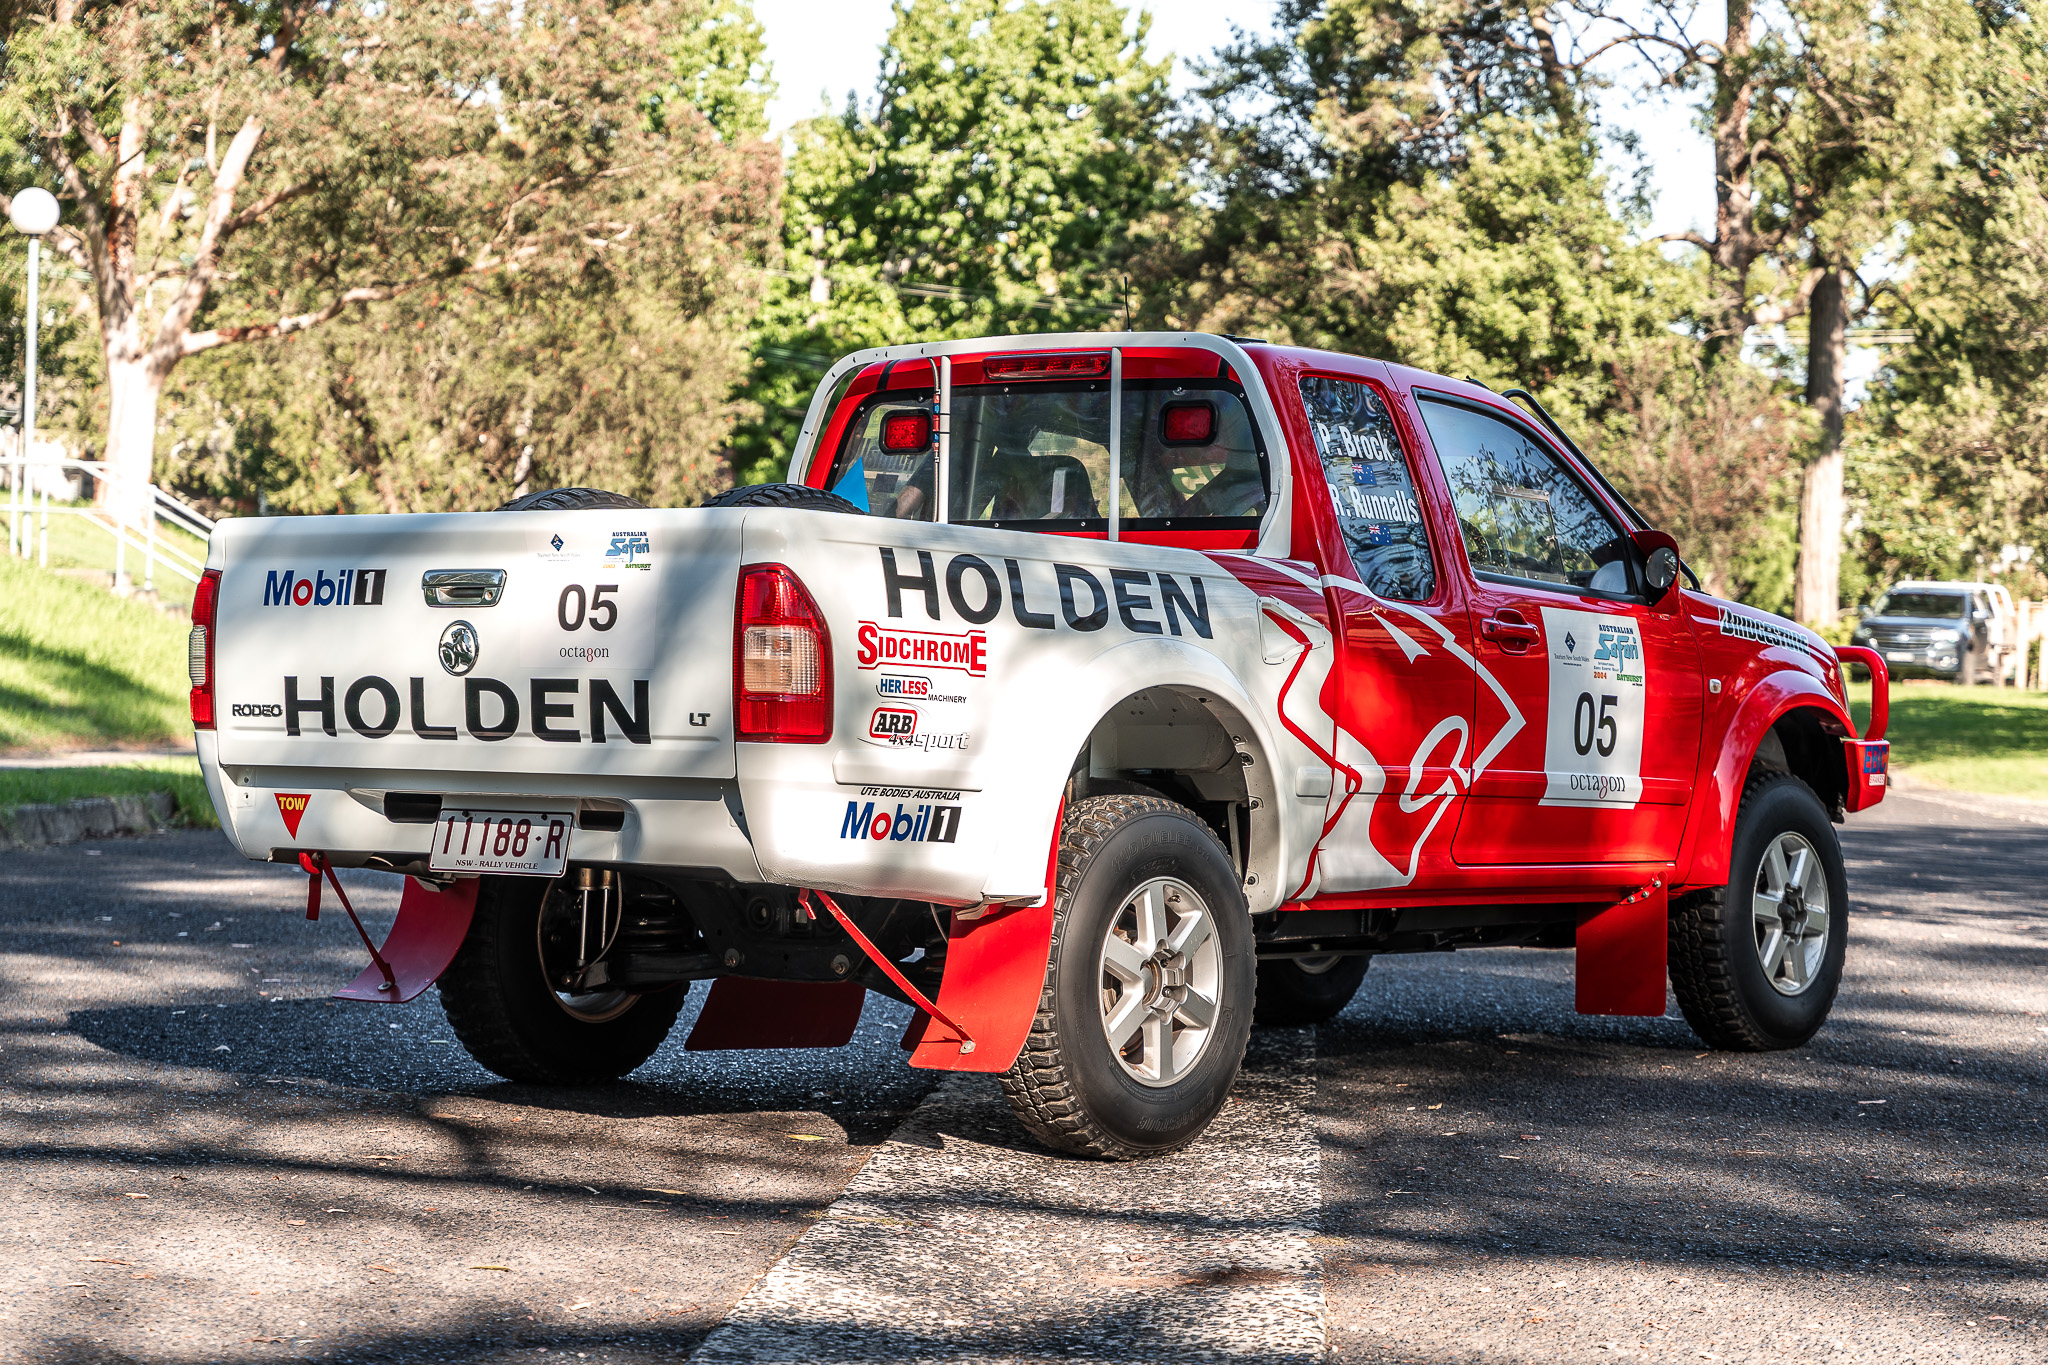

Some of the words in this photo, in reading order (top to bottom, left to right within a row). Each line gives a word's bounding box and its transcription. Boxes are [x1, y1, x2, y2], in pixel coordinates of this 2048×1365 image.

[1339, 425, 1395, 461] Brock
[1349, 485, 1420, 524] Runnalls
[605, 537, 650, 563] Safari
[878, 546, 1214, 640] HOLDEN
[558, 583, 619, 631] 05
[1598, 624, 1634, 634] AUSTRALIAN
[1718, 605, 1811, 657] BRIDGESTONE
[559, 645, 609, 662] octagon
[857, 624, 987, 672] SIDCHROME
[1594, 633, 1639, 673] Safari
[880, 678, 928, 695] HERLESS
[1593, 671, 1607, 679] 2004
[1616, 673, 1643, 682] BATHURST
[232, 703, 283, 717] RODEO
[284, 675, 652, 744] HOLDEN
[927, 693, 967, 704] MACHINERY
[689, 712, 711, 727] LT
[874, 713, 913, 734] ARB
[1574, 691, 1618, 757] 05
[1863, 745, 1888, 774] EBC
[860, 786, 880, 796] UTE
[879, 788, 913, 799] BODIES
[912, 789, 961, 801] AUSTRALIA
[1570, 772, 1626, 799] octagon
[279, 796, 306, 811] TOW
[455, 859, 474, 867] NSW
[479, 860, 502, 868] RALLY
[505, 861, 539, 870] VEHICLE
